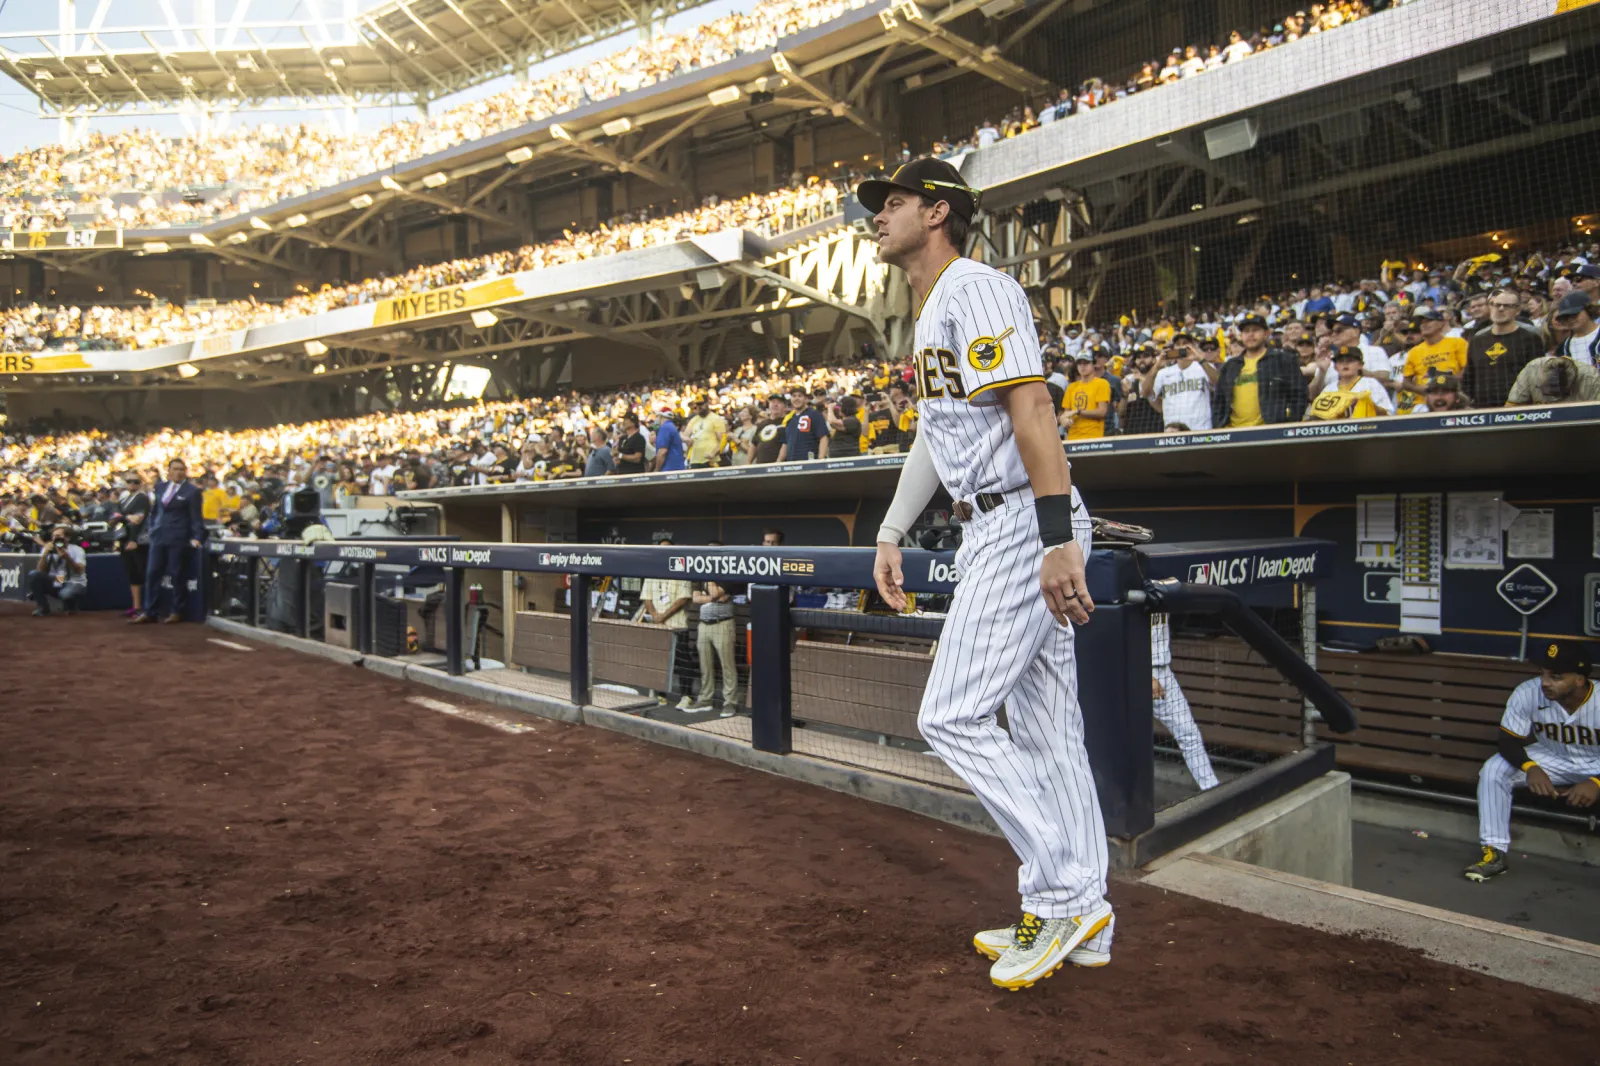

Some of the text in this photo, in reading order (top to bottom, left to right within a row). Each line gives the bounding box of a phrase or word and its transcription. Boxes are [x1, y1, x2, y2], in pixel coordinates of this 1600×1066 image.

[392, 288, 467, 321] MYERS
[1455, 411, 1552, 426] NLCS loanDepot
[1295, 424, 1358, 436] POSTSEASON
[1165, 437, 1186, 445] NLCS
[345, 547, 377, 558] POSTSEASON
[428, 548, 491, 565] NLCS loanDepot
[550, 553, 569, 567] enjoy
[569, 553, 581, 565] the
[686, 556, 814, 576] POSTSEASON 2022
[1209, 553, 1316, 586] NLCS loanDepot
